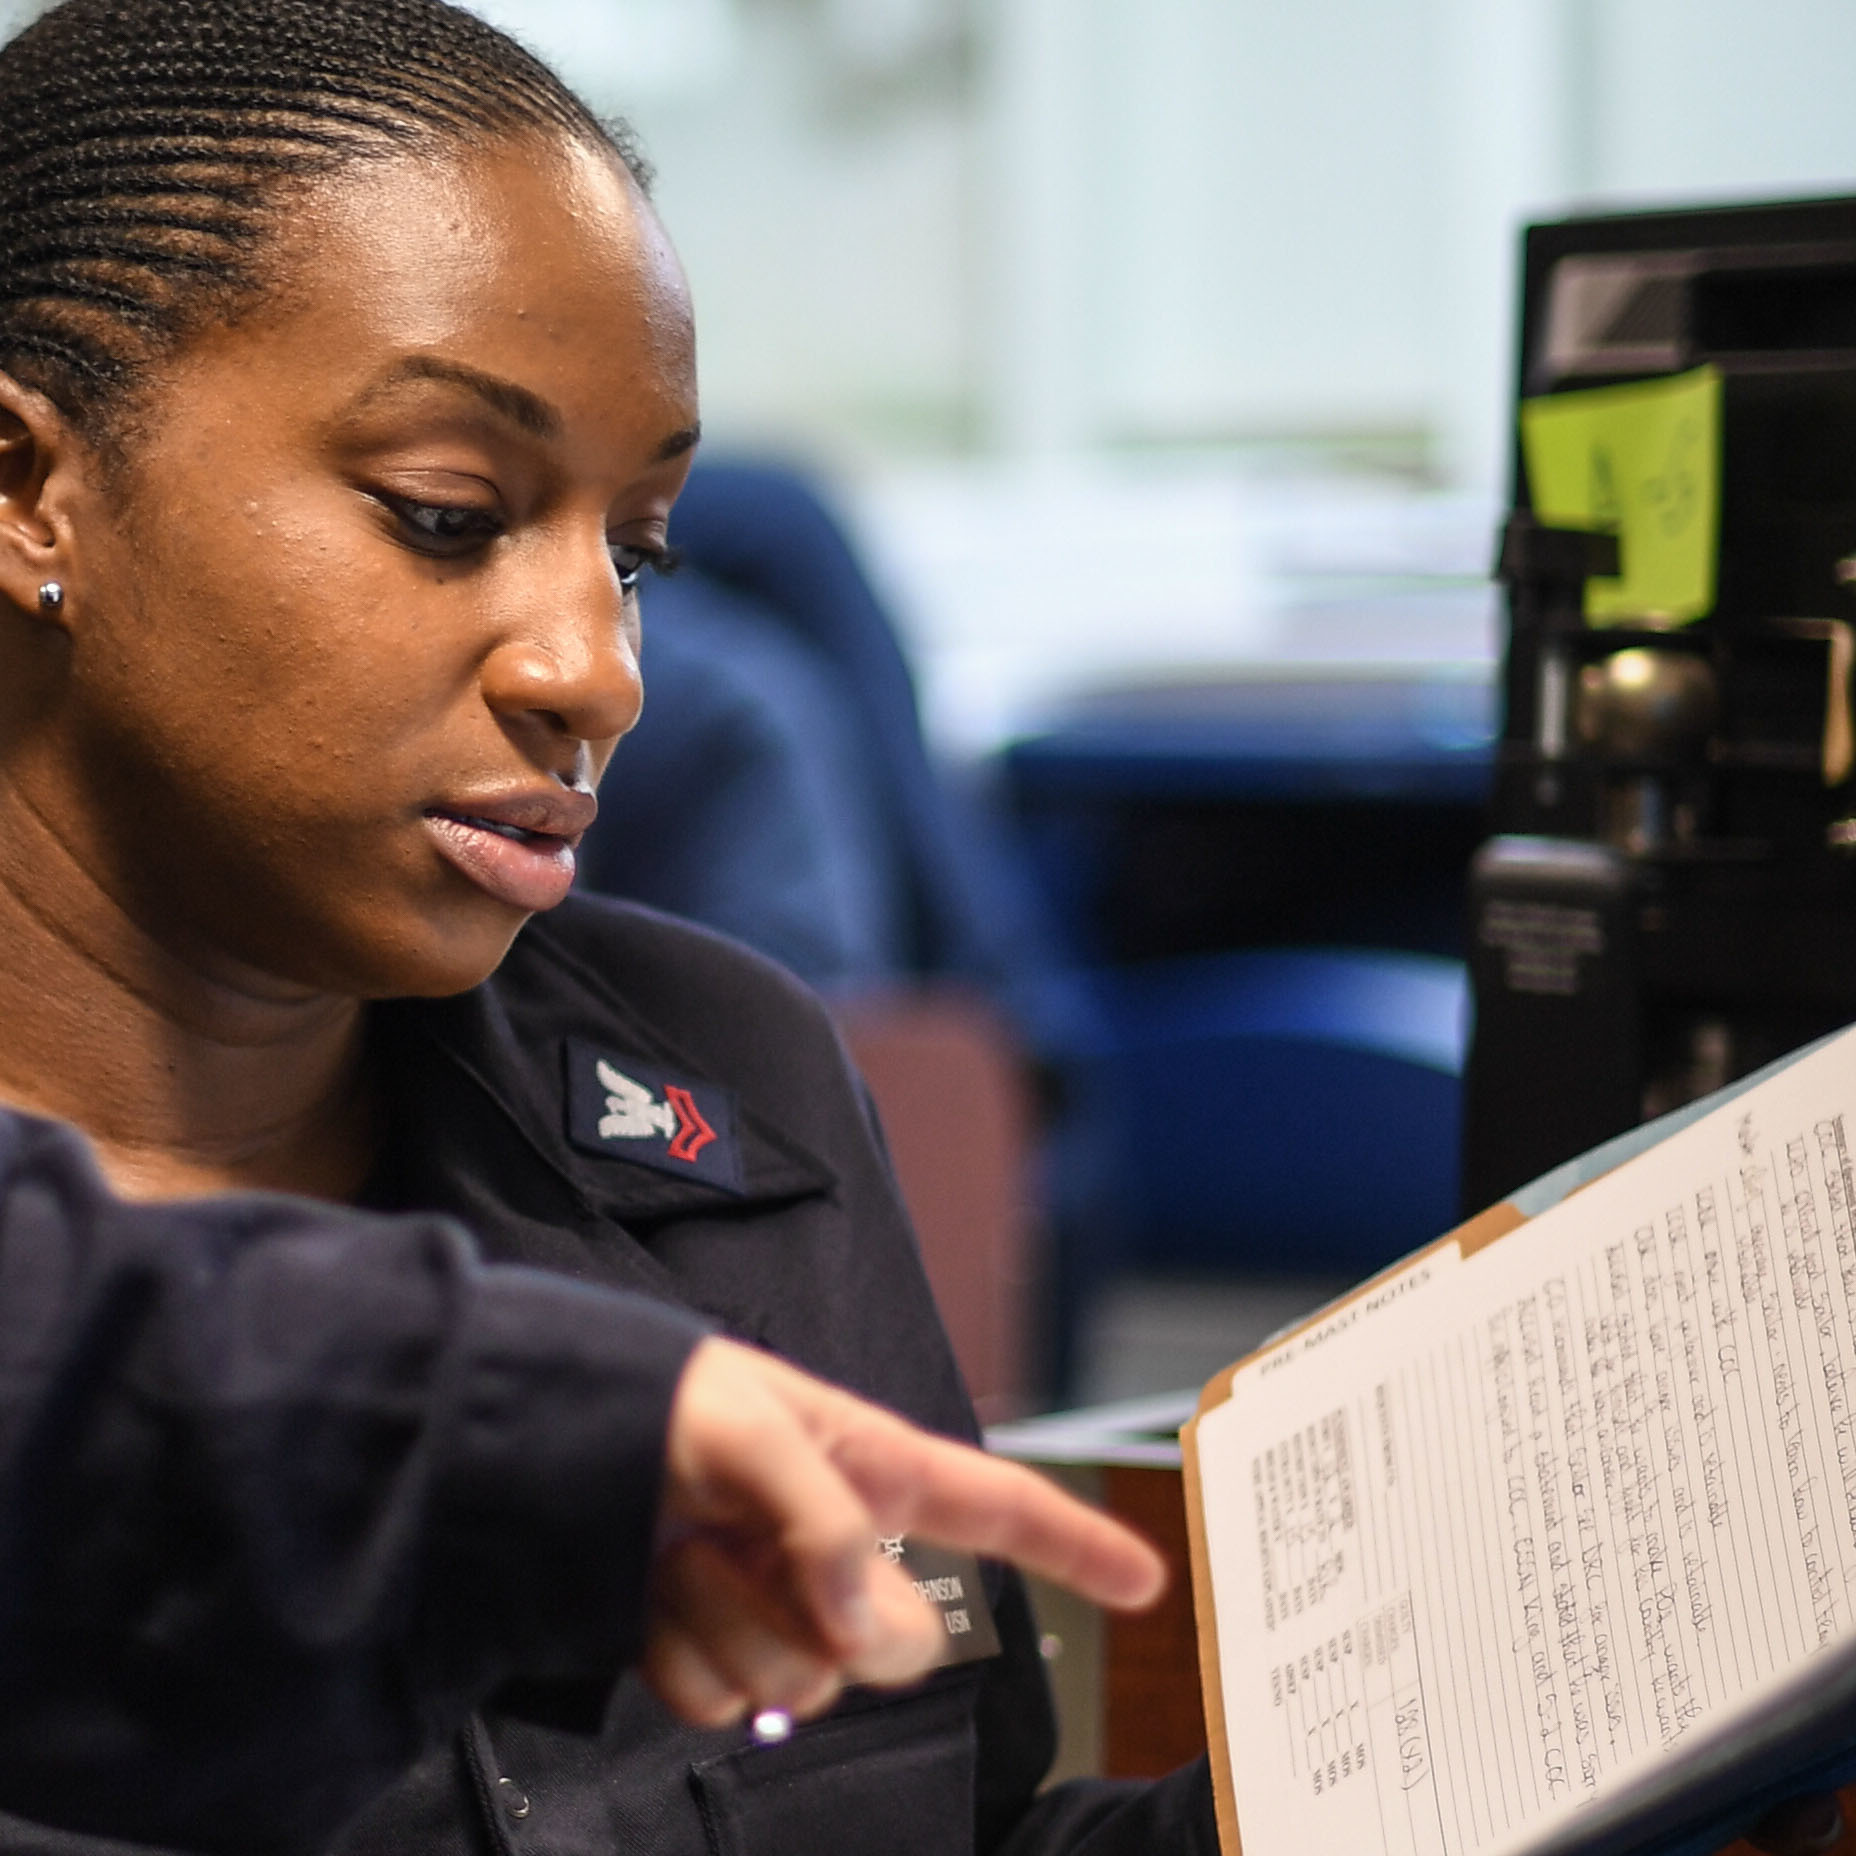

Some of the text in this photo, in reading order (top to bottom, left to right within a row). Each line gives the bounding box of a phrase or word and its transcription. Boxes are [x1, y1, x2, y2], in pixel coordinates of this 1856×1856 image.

[1365, 1268, 1432, 1313] NOTES
[910, 1576, 964, 1604] OHNSON
[945, 1608, 972, 1635] USN
